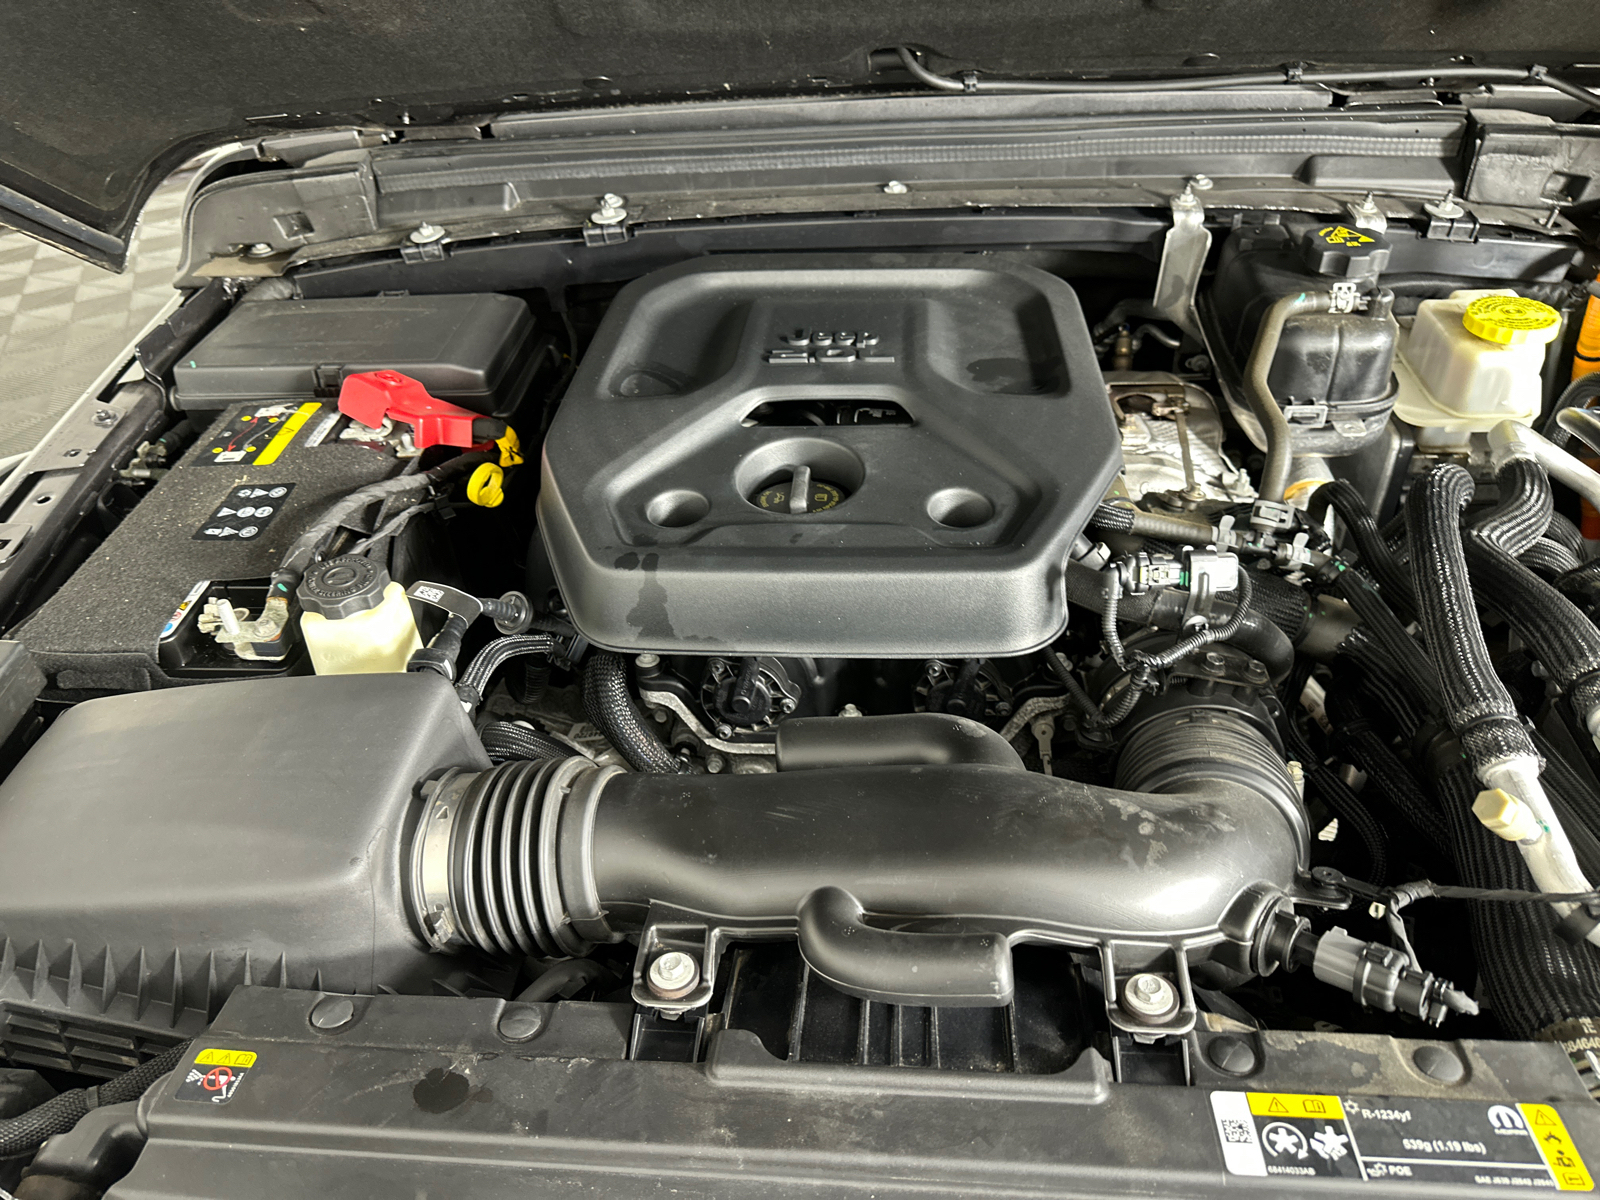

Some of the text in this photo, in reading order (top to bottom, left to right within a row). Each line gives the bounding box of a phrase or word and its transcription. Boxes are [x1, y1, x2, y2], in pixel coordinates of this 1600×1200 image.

[785, 327, 879, 348] Jeep
[769, 348, 895, 363] 2.0L
[1361, 1108, 1412, 1123] R-1234yf
[1432, 1140, 1461, 1153] (1.19
[1461, 1141, 1487, 1155] lbs)
[1388, 1165, 1413, 1177] POE
